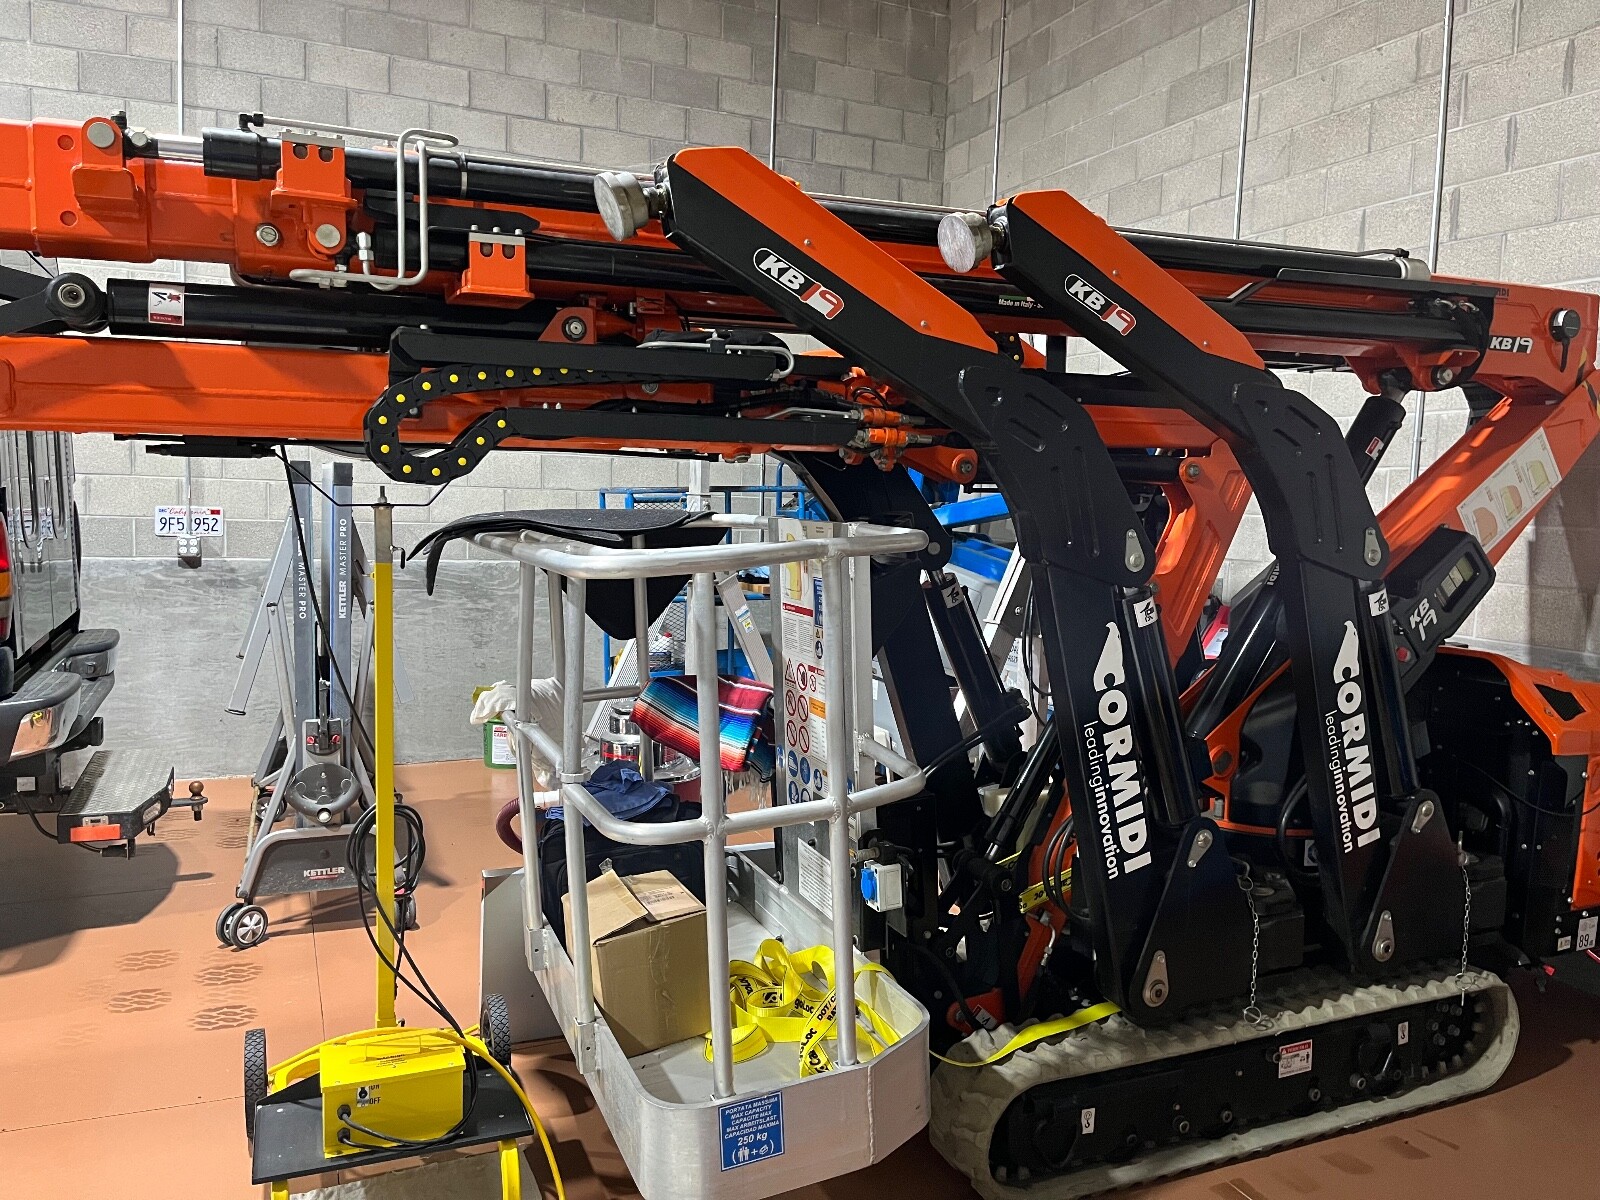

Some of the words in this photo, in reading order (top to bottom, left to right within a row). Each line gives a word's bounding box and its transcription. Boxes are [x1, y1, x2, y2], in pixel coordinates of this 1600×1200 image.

[1020, 301, 1034, 309] Italy
[159, 516, 219, 532] 9F5952
[298, 562, 307, 598] MASTER
[339, 580, 347, 619] KETTLER
[299, 600, 307, 619] PRO
[1409, 598, 1430, 630] KB
[1418, 608, 1438, 642] 19
[1333, 628, 1381, 848] CORMIDI
[1093, 630, 1152, 874] CORMIDI
[303, 866, 346, 878] KETTLER
[1578, 933, 1590, 948] 89
[369, 1096, 381, 1105] OFF
[725, 1104, 752, 1115] PORTATA
[730, 1112, 744, 1120] MAX
[744, 1104, 773, 1116] CAPACITY
[731, 1114, 759, 1126] CAPACITE
[759, 1110, 773, 1118] MAX
[724, 1127, 757, 1139] CAPACIDAD
[758, 1120, 780, 1130] MAXIMA
[726, 1123, 741, 1133] MAX
[740, 1115, 777, 1129] ARBEITSLAST
[738, 1134, 754, 1146] 250
[756, 1132, 768, 1141] kg
